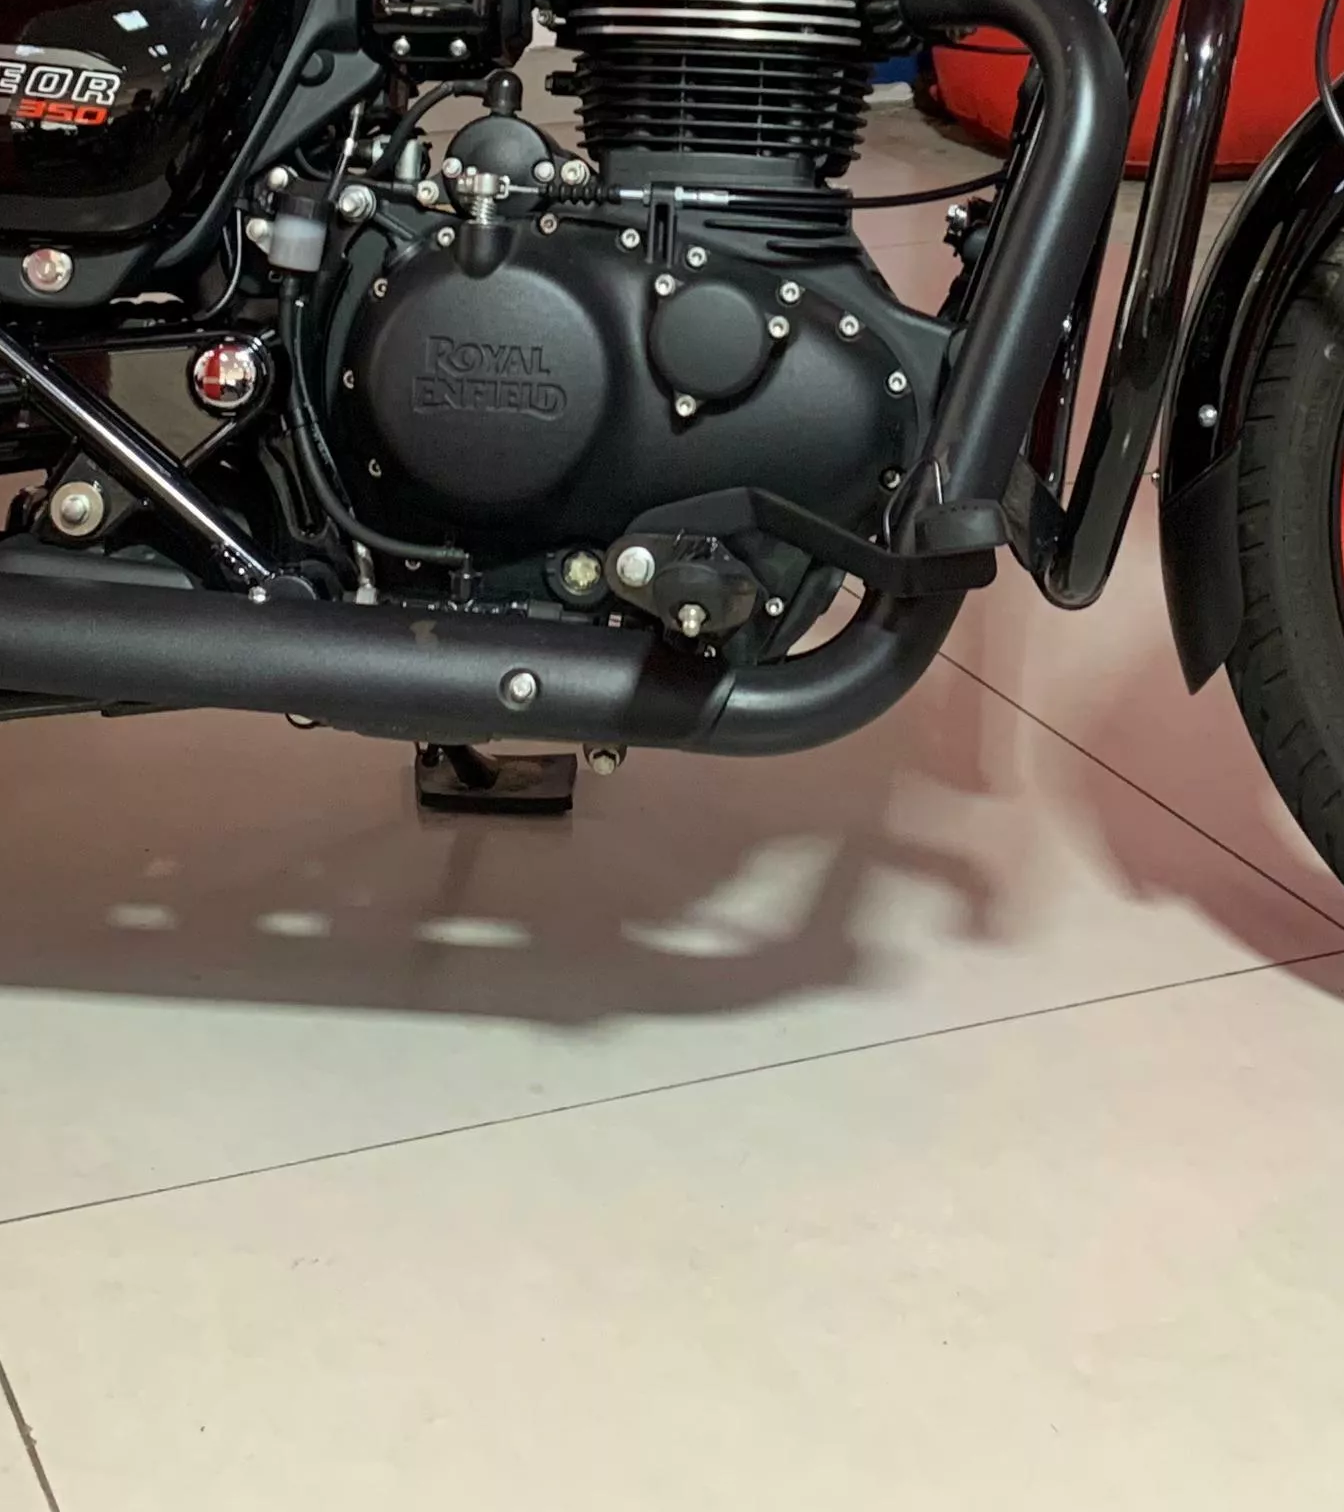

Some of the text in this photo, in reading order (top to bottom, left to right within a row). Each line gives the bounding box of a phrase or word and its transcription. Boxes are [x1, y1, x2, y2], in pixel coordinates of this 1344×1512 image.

[16, 98, 109, 125] 350
[425, 335, 551, 377] ROYAL
[412, 376, 567, 421] ENFIELD
